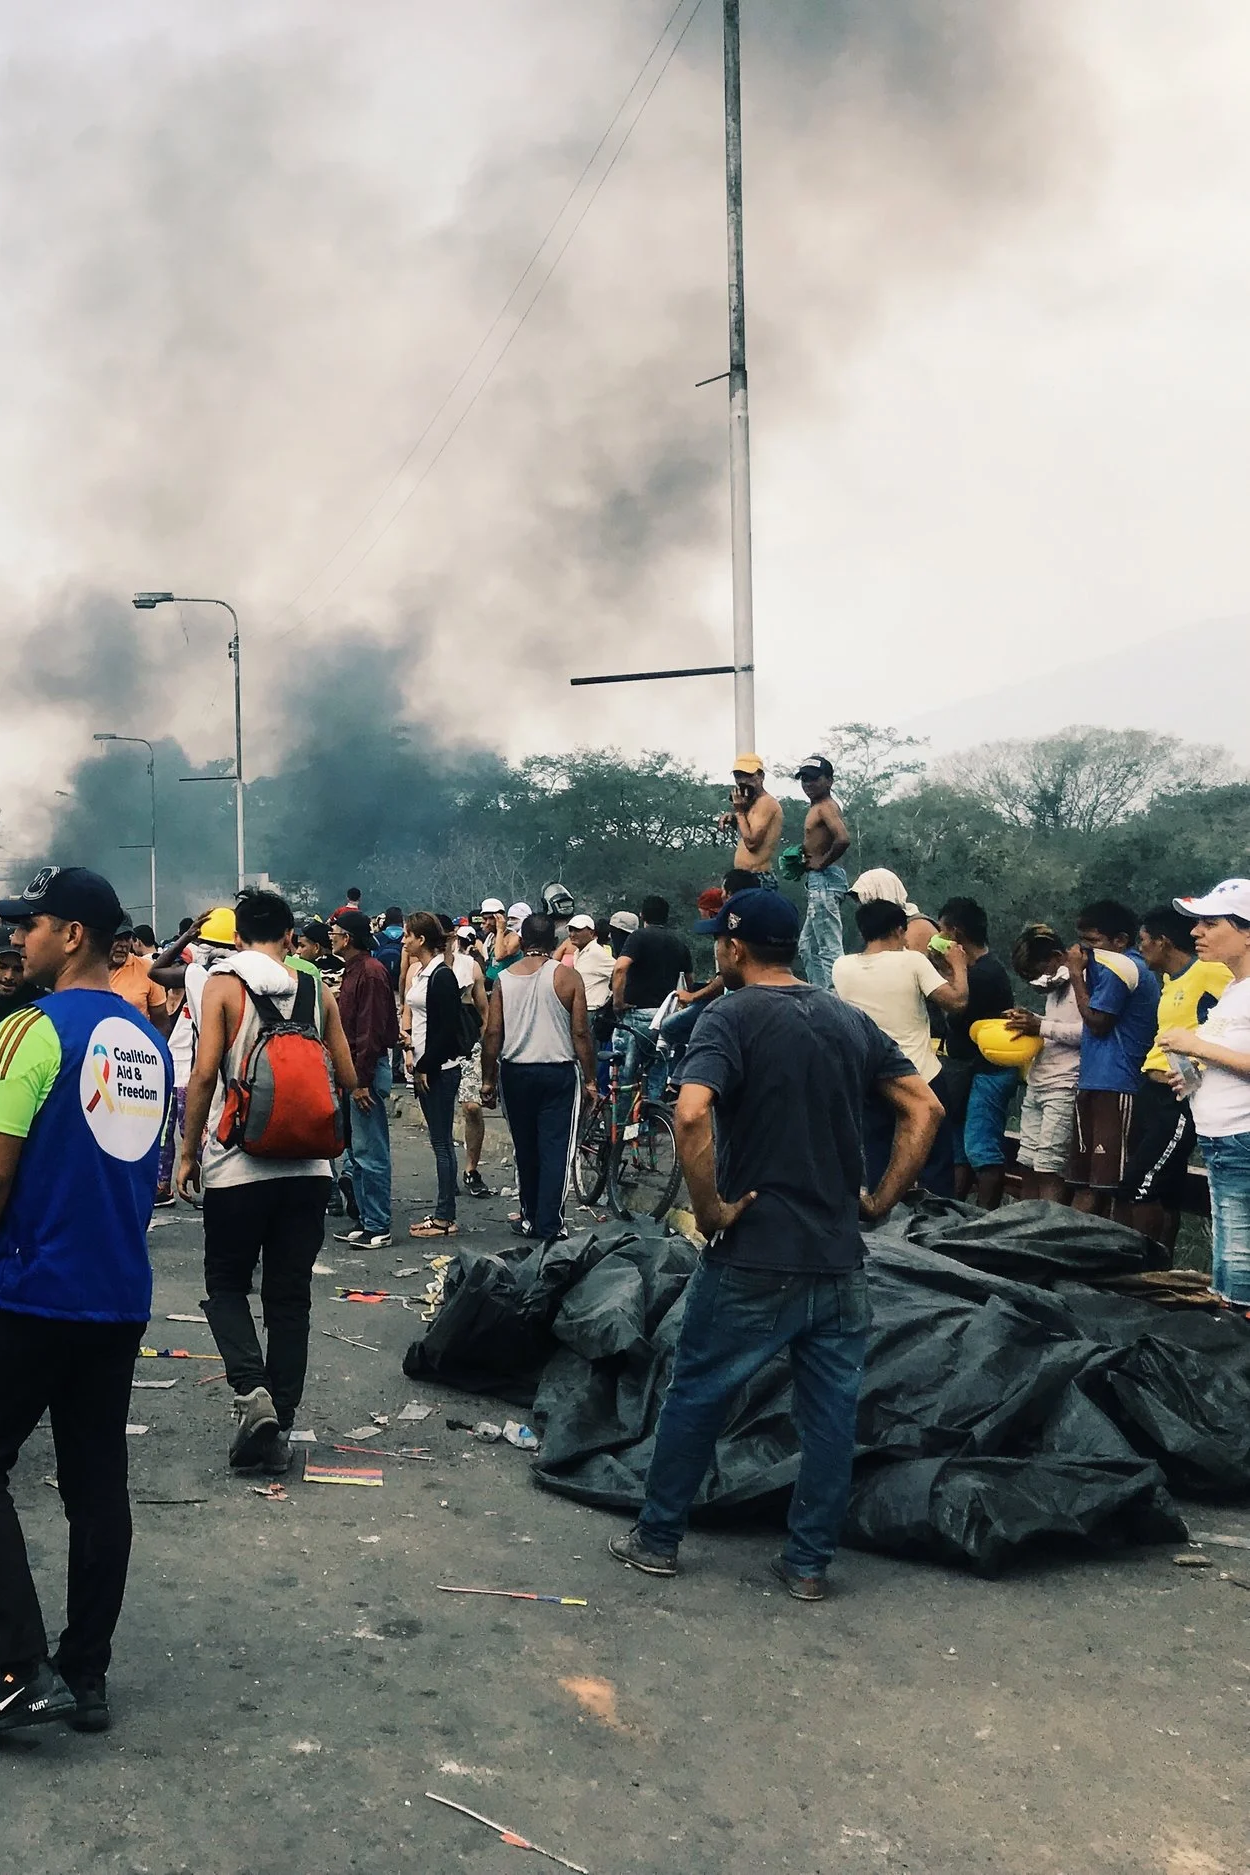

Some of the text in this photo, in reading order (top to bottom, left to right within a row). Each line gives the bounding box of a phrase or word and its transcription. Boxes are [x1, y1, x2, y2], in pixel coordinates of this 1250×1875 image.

[113, 1046, 158, 1066] Coalition
[116, 1064, 142, 1081] Aid &
[117, 1082, 158, 1101] Freedom
